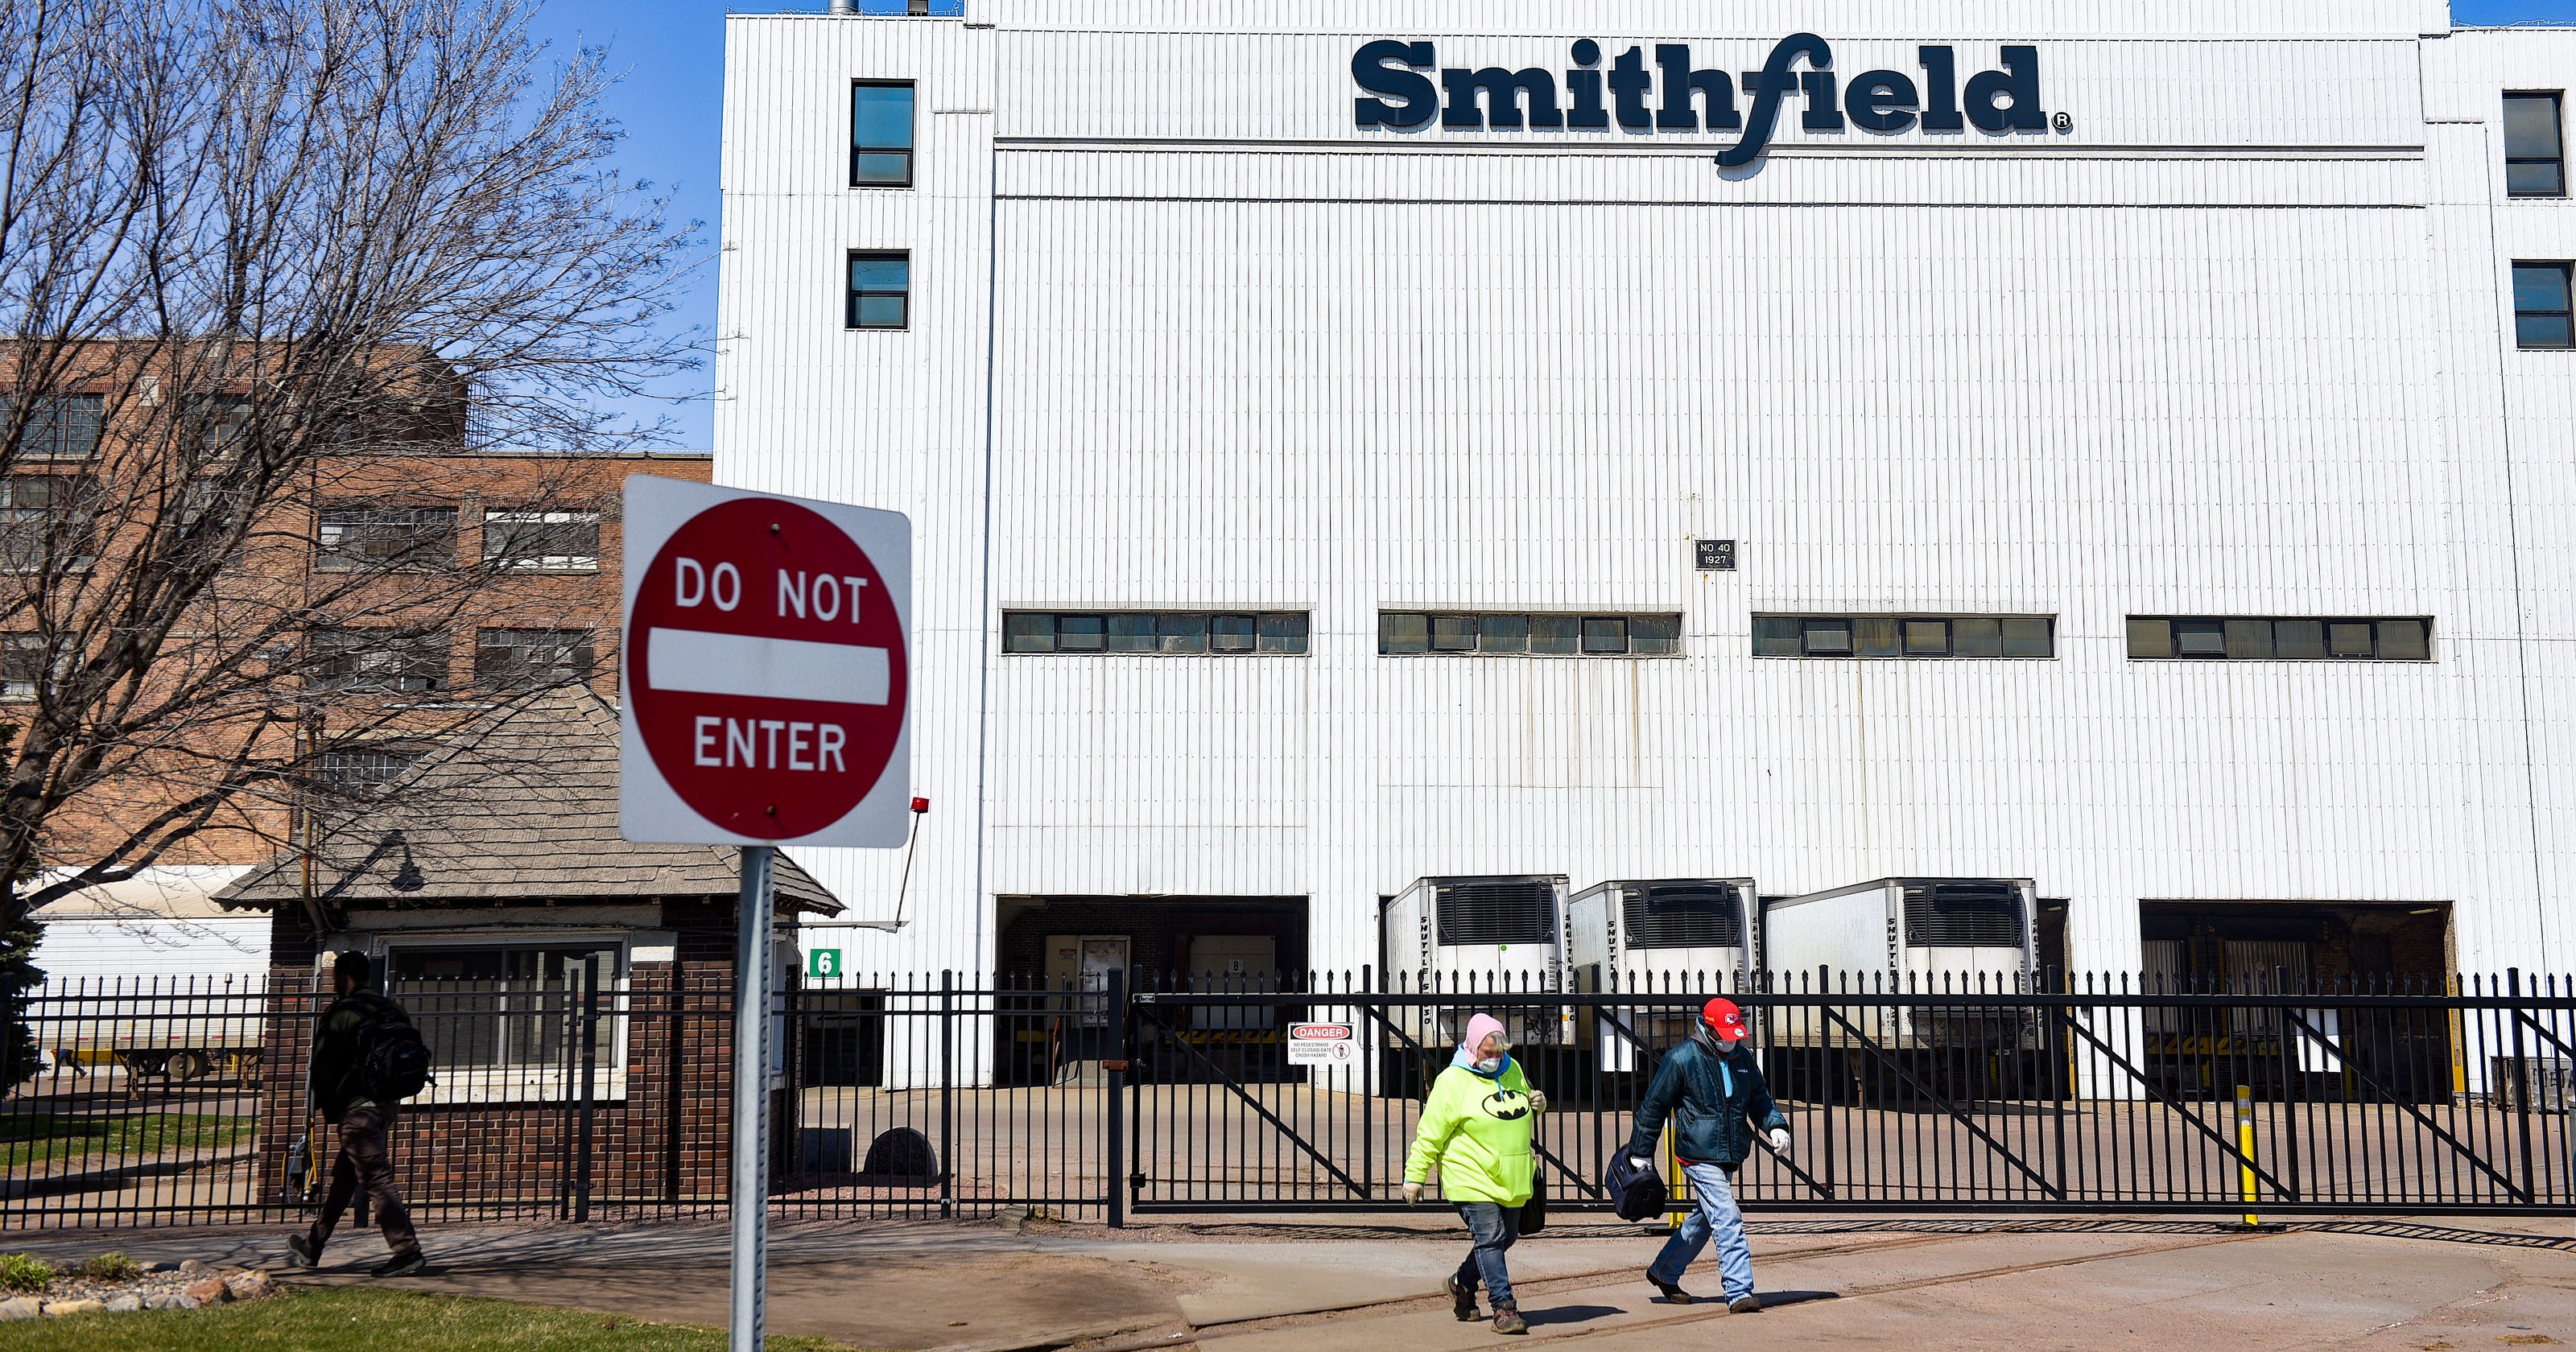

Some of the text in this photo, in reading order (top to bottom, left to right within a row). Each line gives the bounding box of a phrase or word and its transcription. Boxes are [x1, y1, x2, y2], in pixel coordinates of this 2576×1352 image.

[1351, 33, 2047, 166] Smithfield
[1700, 543, 1731, 552] NO 40
[1704, 555, 1727, 564] 1927
[675, 557, 869, 624] DO NOT
[694, 715, 847, 773] ENTER
[1564, 913, 1573, 972] SHUTTLE
[818, 951, 832, 975] 6
[1233, 961, 1239, 971] 8
[1299, 1028, 1344, 1037] DANGER
